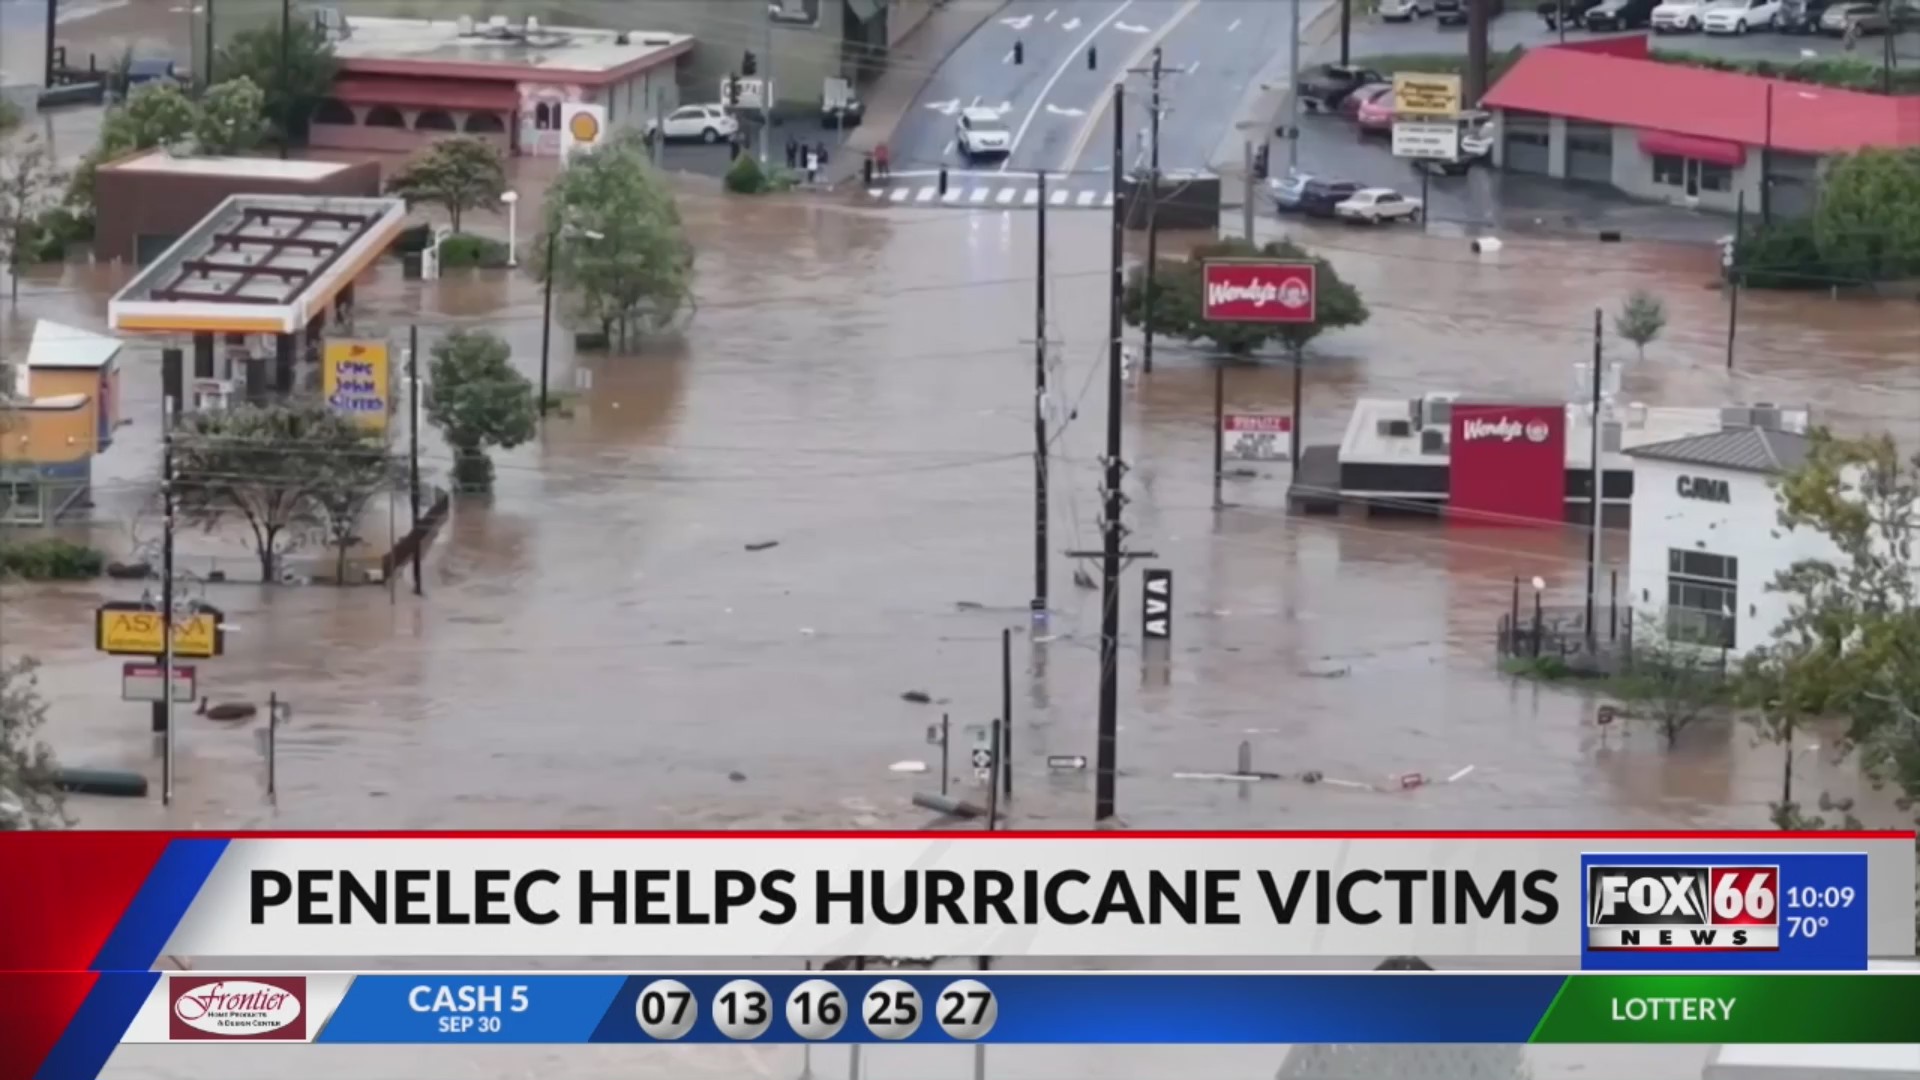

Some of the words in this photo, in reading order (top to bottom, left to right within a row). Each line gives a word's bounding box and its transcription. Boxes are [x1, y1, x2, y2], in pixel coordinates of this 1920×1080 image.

[1209, 277, 1277, 307] Wendy's
[1463, 416, 1523, 442] Wendy's
[1677, 474, 1731, 504] CAVA
